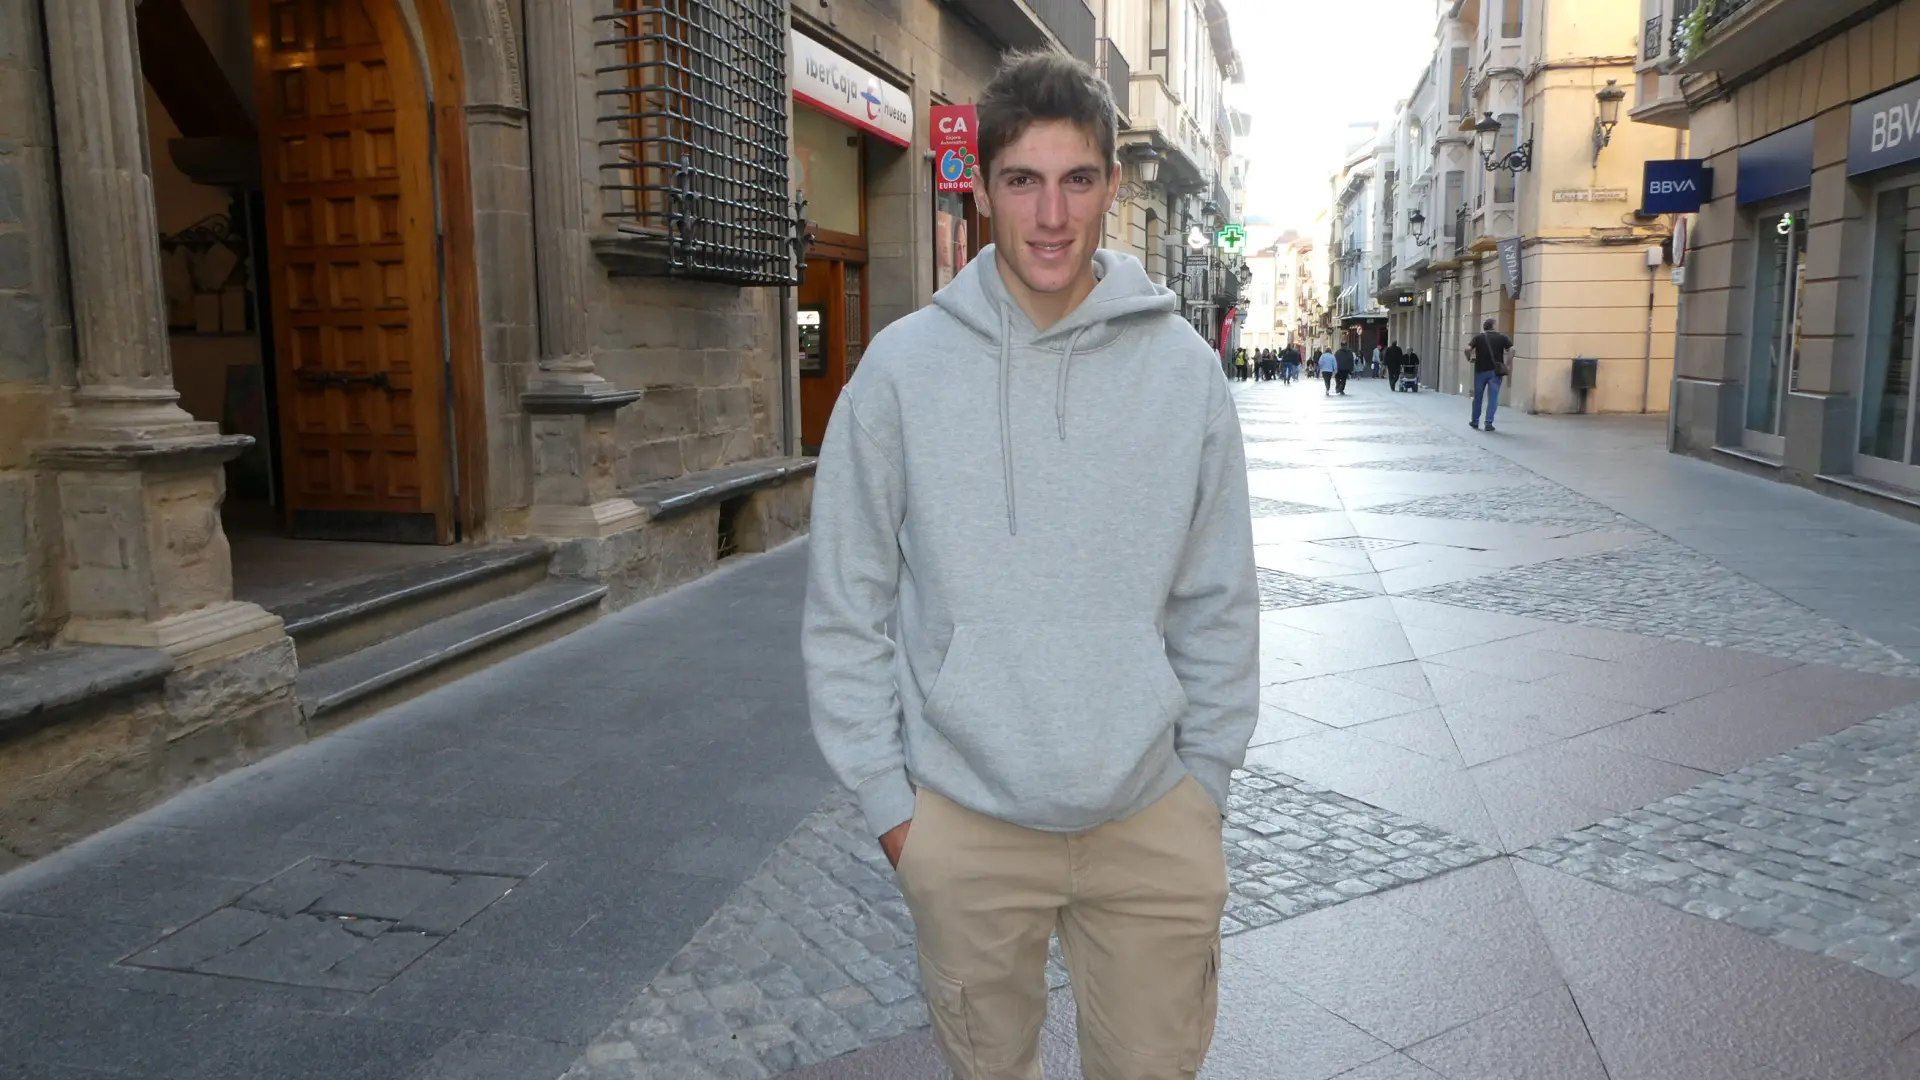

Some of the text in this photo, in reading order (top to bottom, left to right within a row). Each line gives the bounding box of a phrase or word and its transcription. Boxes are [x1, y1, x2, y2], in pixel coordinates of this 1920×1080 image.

[938, 116, 968, 133] CA
[1871, 98, 1920, 152] BBV
[939, 182, 958, 190] EURO
[1649, 178, 1696, 194] BBVA
